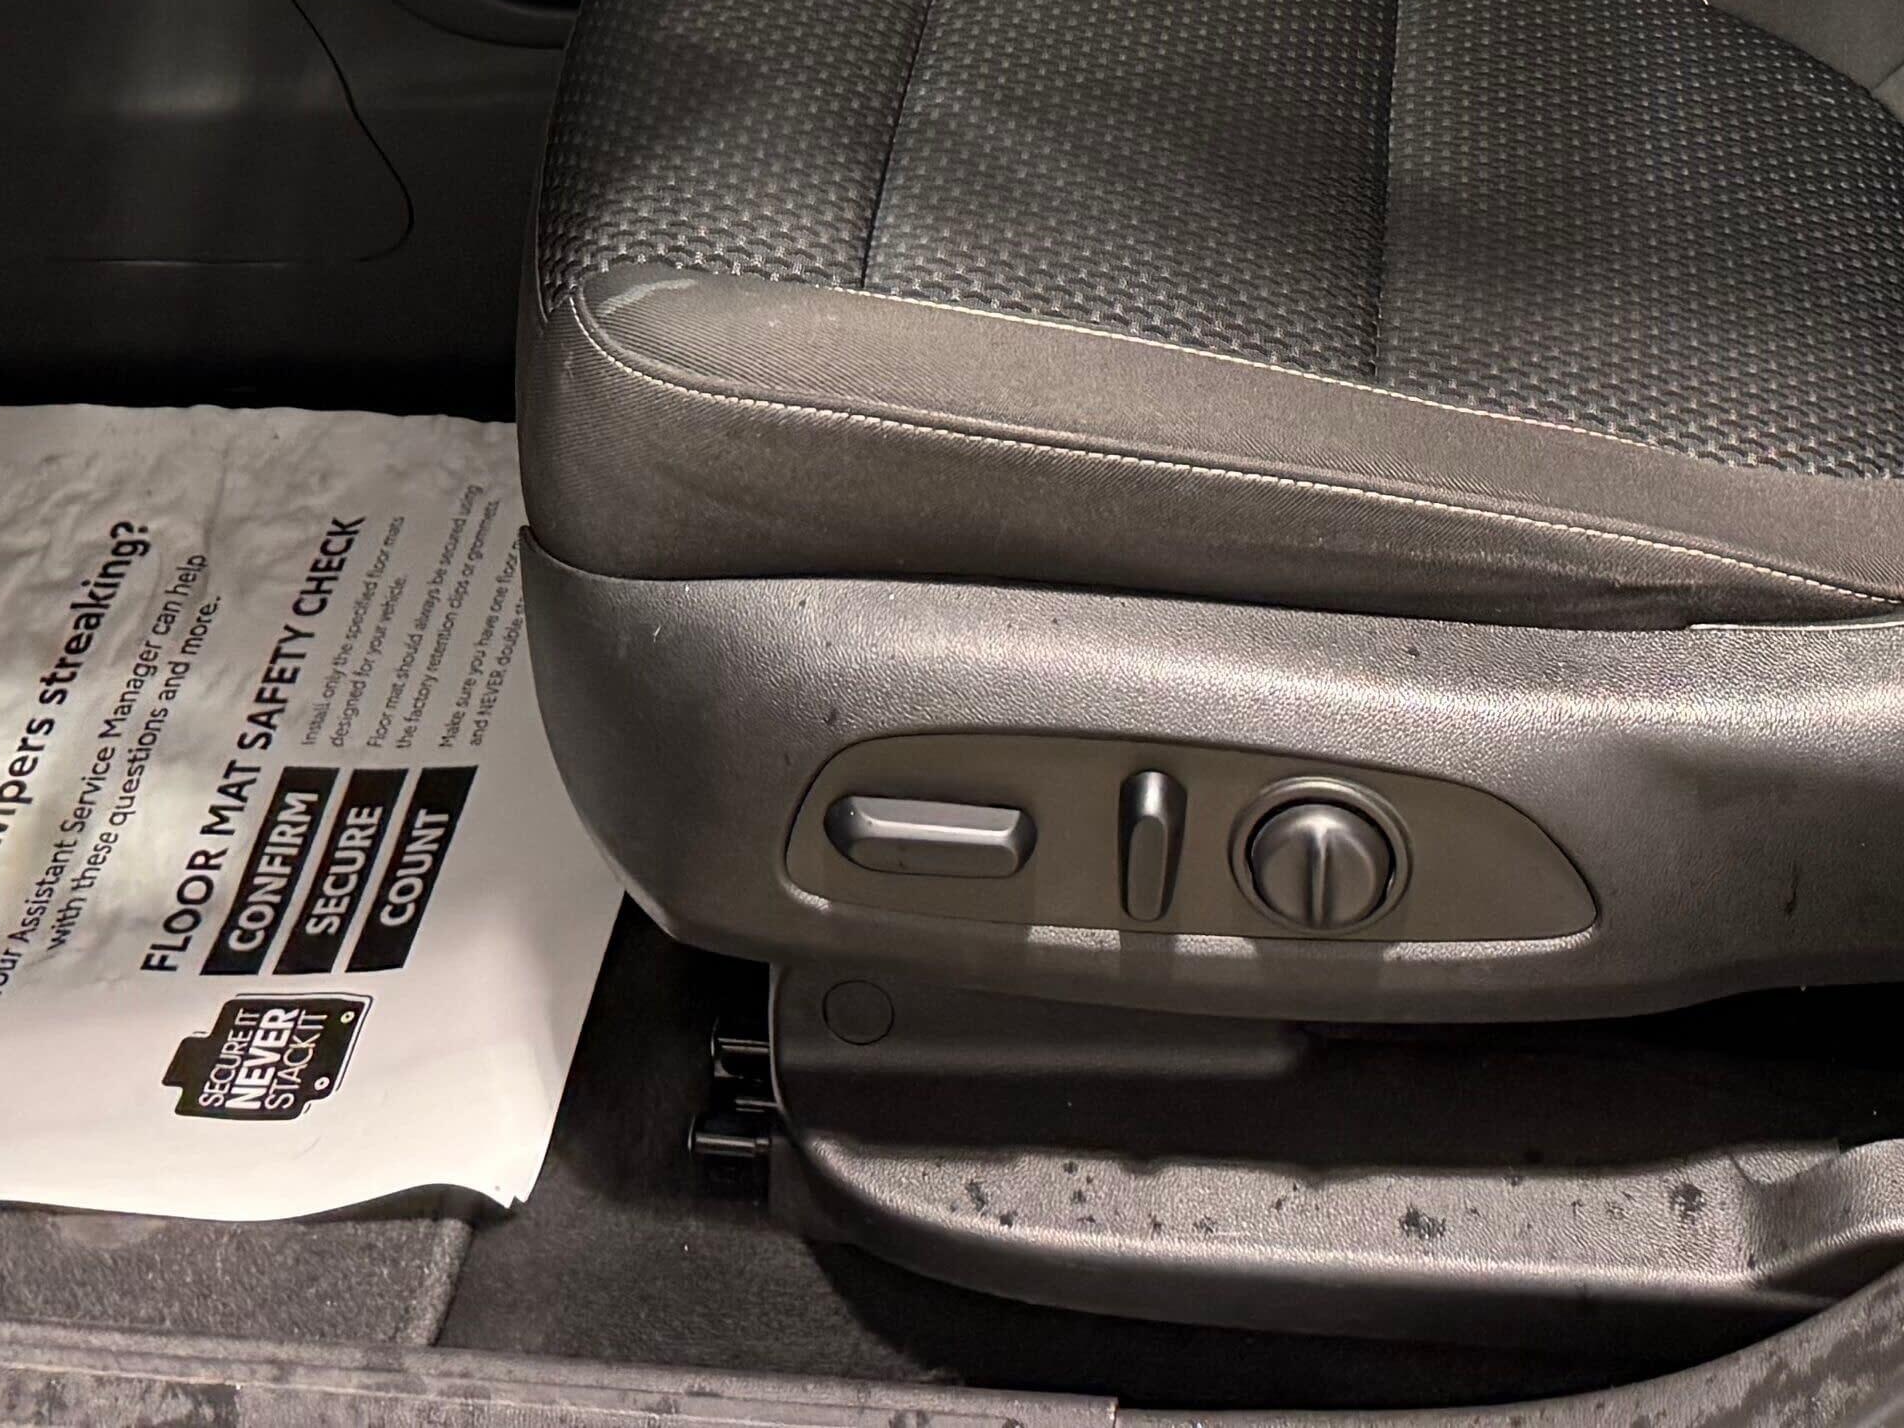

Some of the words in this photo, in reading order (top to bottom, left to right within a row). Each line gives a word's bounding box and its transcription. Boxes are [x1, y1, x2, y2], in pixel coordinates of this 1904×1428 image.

[384, 516, 405, 546] mats
[440, 518, 467, 565] secured
[165, 554, 207, 595] help
[366, 549, 389, 578] floor
[427, 568, 447, 584] be
[462, 564, 475, 577] or
[39, 521, 151, 705] streaking?
[346, 580, 378, 639] specified
[414, 588, 441, 630] always
[448, 580, 469, 608] clips
[490, 586, 508, 612] one
[152, 601, 182, 636] can
[475, 616, 499, 646] have
[332, 644, 353, 666] the
[396, 634, 423, 680] should
[427, 612, 458, 673] retention
[469, 650, 486, 675] you
[497, 617, 523, 666] double
[98, 640, 163, 739] Manager
[323, 668, 347, 699] only
[330, 680, 367, 747] designed
[353, 658, 375, 677] for
[367, 626, 387, 655] your
[386, 683, 405, 709] mat
[403, 674, 439, 722] factory
[456, 678, 477, 708] sure
[477, 670, 506, 715] NEVER
[140, 848, 228, 972] FLOOR
[200, 759, 262, 836] MAT
[237, 624, 315, 751] SAFETY
[292, 515, 366, 616] CHECK
[301, 702, 330, 745] Install
[366, 712, 392, 748] Floor
[396, 725, 417, 748] the
[439, 711, 465, 747] Make
[470, 720, 488, 746] and
[47, 894, 87, 951] with
[71, 831, 118, 891] these
[109, 707, 168, 825] questions
[159, 661, 190, 701] and
[181, 596, 221, 656] more.
[60, 745, 115, 834] Service
[228, 792, 319, 952] CONFIRM
[305, 805, 384, 935] SECURE
[379, 808, 450, 927] COUNT
[7, 839, 77, 944] Assistant
[198, 1030, 254, 1107] SECURE
[235, 1008, 260, 1025] IT
[224, 1008, 300, 1111] NEVER
[264, 1030, 316, 1109] STACK
[299, 1010, 329, 1029] IT
